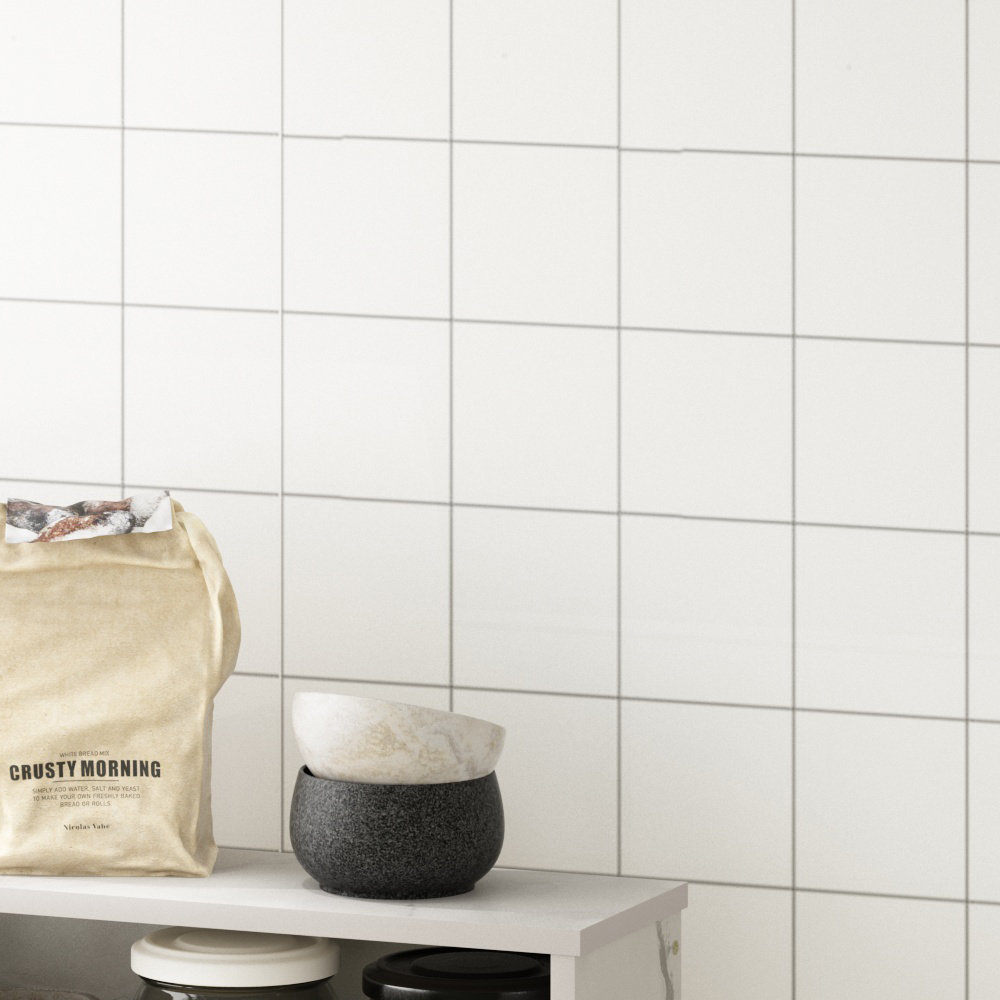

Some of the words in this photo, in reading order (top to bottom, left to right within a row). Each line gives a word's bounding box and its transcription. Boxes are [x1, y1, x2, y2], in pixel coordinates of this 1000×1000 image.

[9, 760, 77, 782] CRUSTY
[80, 759, 162, 778] MORNING
[63, 823, 91, 831] Nicolas
